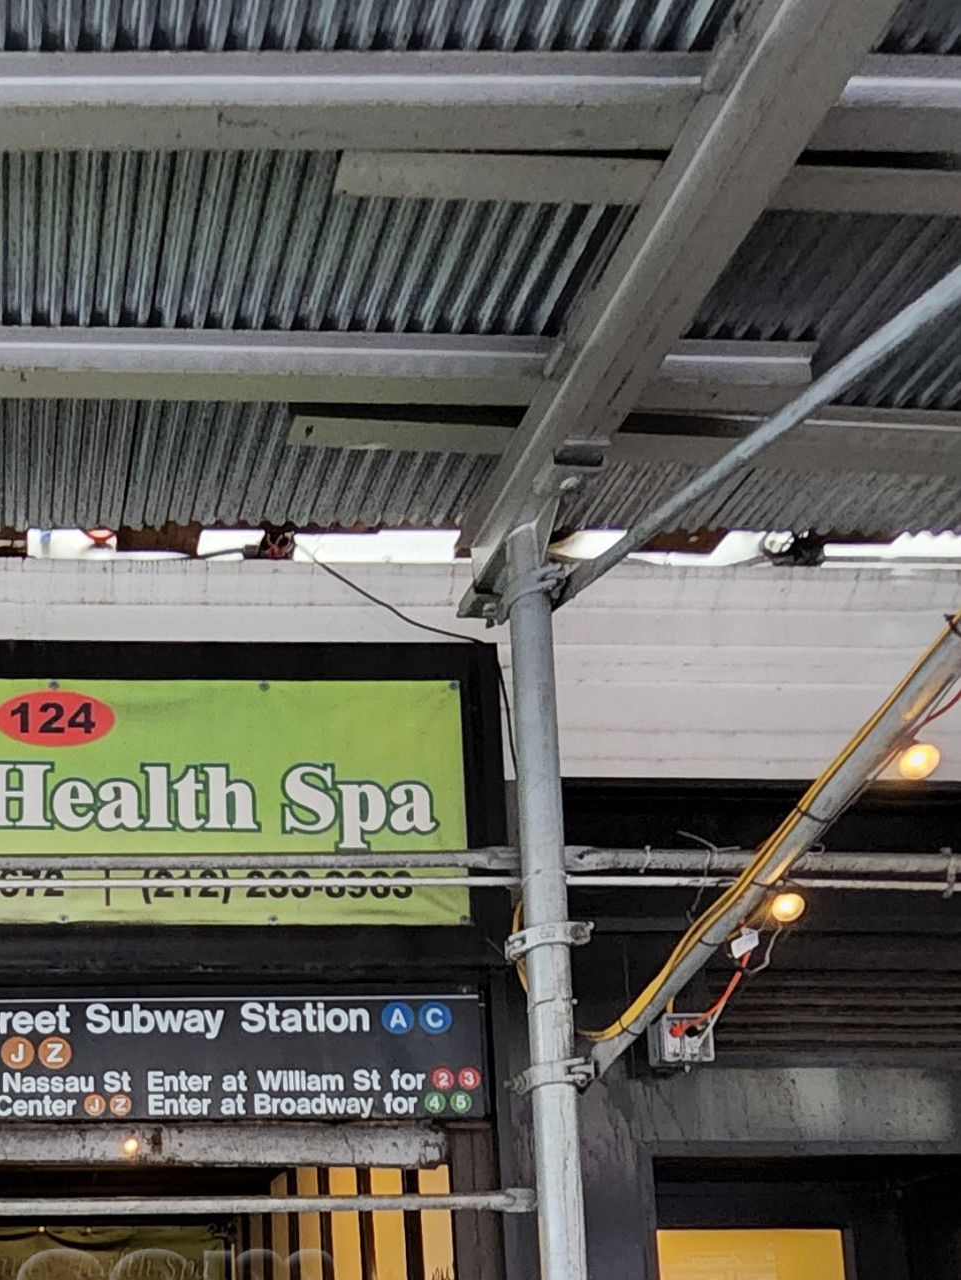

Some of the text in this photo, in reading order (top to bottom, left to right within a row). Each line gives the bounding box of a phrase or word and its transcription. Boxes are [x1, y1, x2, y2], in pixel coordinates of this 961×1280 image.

[8, 701, 97, 735] 124
[281, 763, 439, 851] Spa
[85, 1002, 225, 1039] Subway
[240, 1001, 371, 1033] Station
[2, 1072, 95, 1094] Nassau
[103, 1071, 132, 1093] St
[147, 1070, 213, 1092] Enter
[222, 1070, 248, 1092] at
[256, 1069, 345, 1092] William
[353, 1069, 381, 1091] St
[390, 1069, 426, 1091] for
[147, 1094, 212, 1115] Enter
[220, 1094, 247, 1115] at
[253, 1092, 374, 1118] Broadway
[383, 1092, 418, 1114] for
